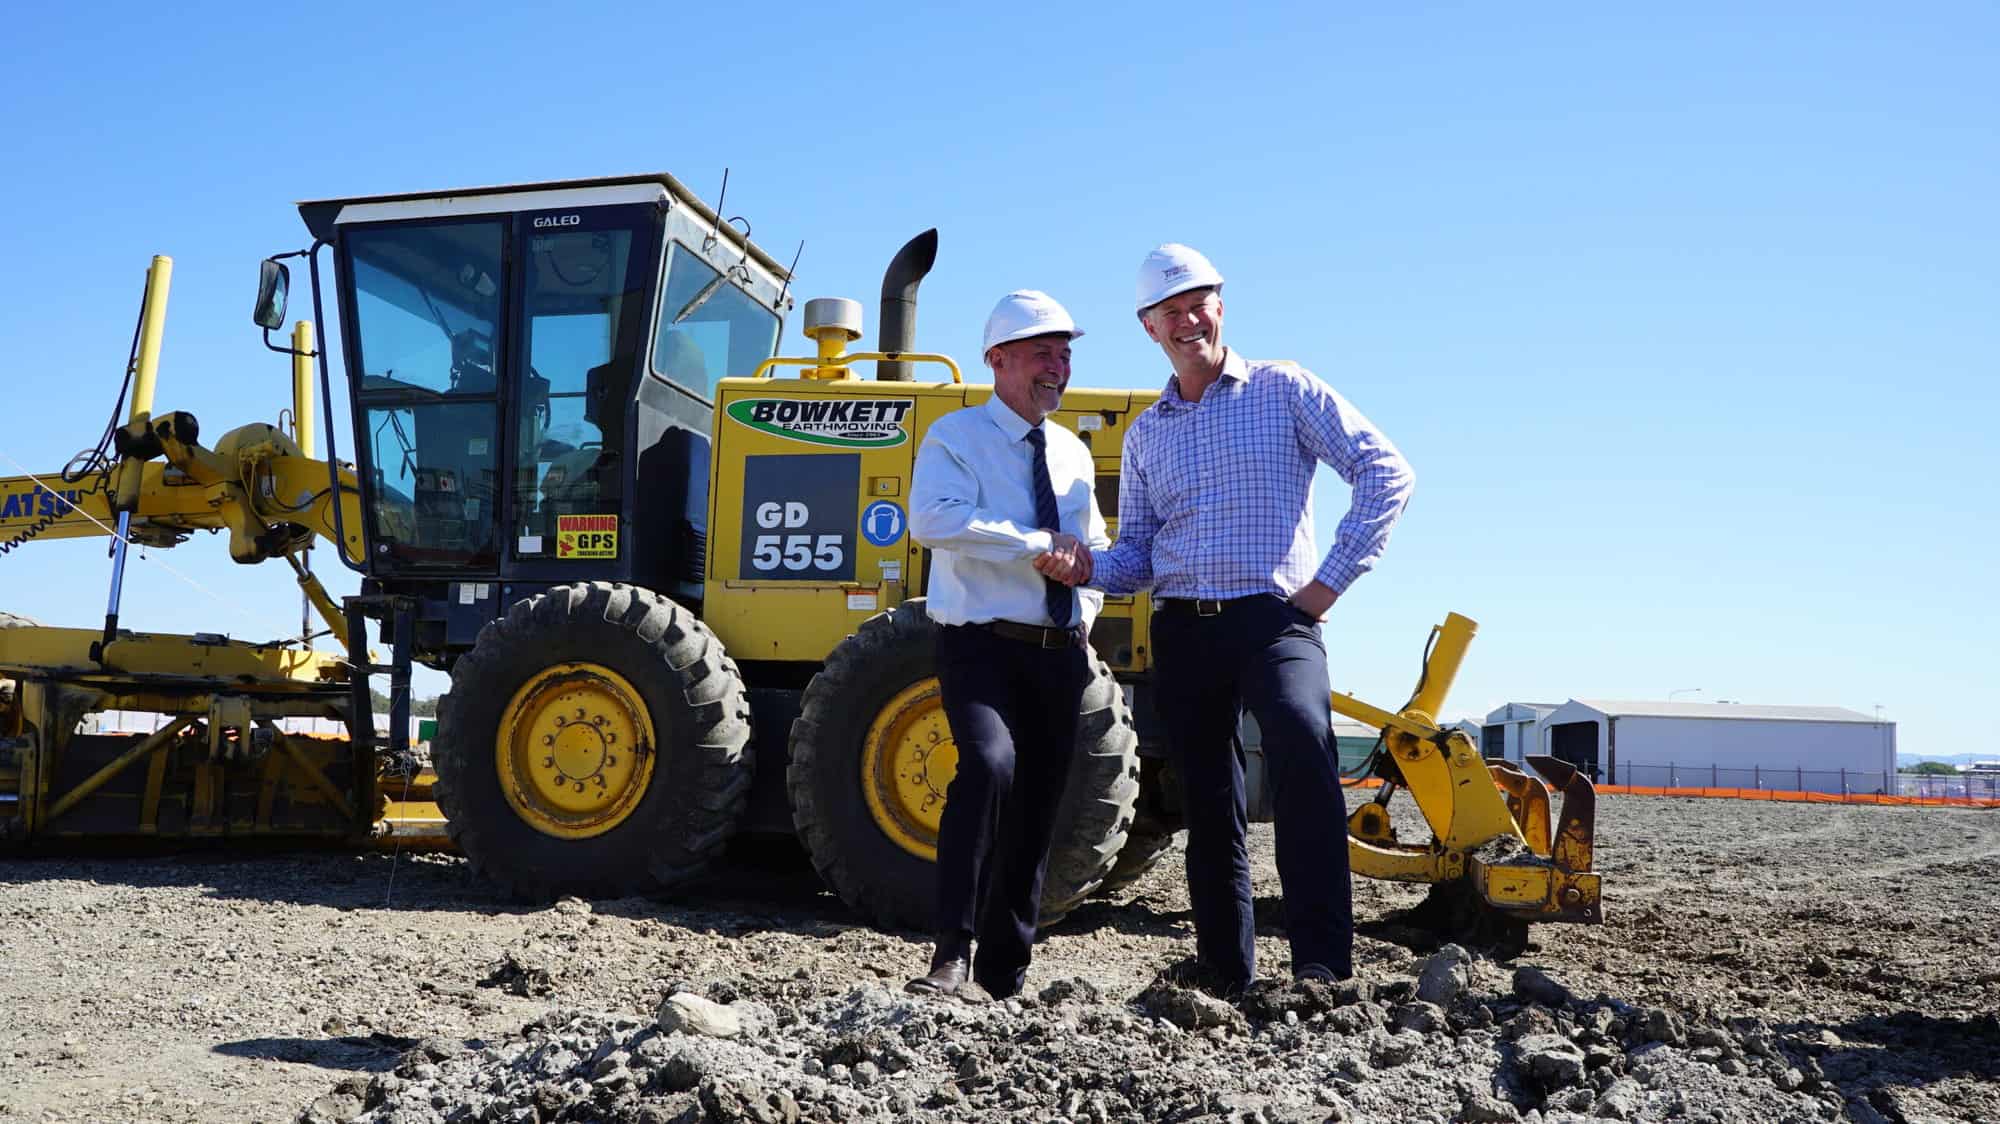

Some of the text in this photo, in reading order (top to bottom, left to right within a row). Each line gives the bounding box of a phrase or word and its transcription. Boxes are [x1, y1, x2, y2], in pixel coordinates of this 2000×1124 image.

[534, 215, 581, 228] GALEO
[752, 401, 912, 423] BOWKETT
[782, 423, 897, 431] EARTHMOVING
[756, 502, 809, 529] GD
[560, 517, 616, 530] WARNING
[578, 534, 614, 549] GPS
[752, 535, 844, 571] 555
